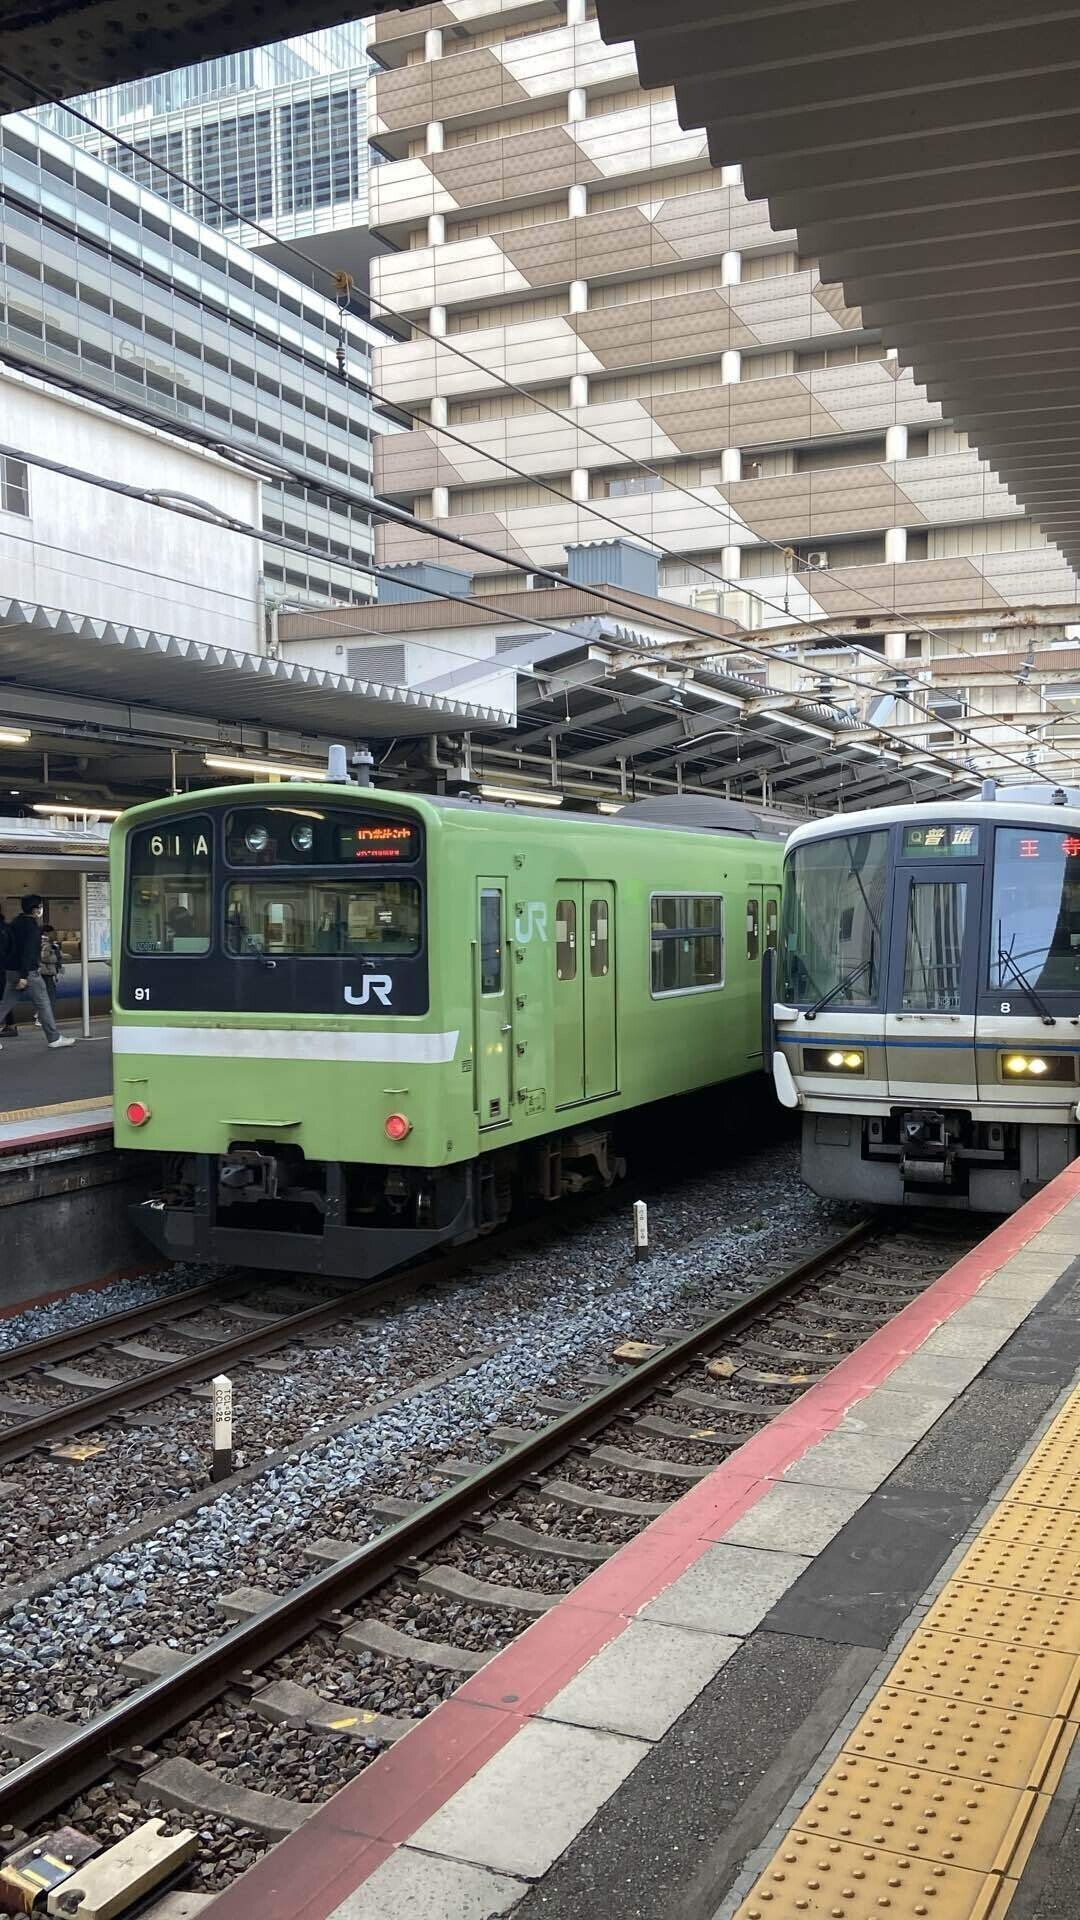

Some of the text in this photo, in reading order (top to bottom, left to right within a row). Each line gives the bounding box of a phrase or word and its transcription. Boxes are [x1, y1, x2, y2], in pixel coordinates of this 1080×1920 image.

[924, 828, 973, 846] 普通
[1020, 838, 1080, 857] 王寺
[515, 901, 548, 943] JR
[134, 987, 150, 1001] 91
[344, 974, 393, 1006] JR
[1000, 1002, 1011, 1014] 8
